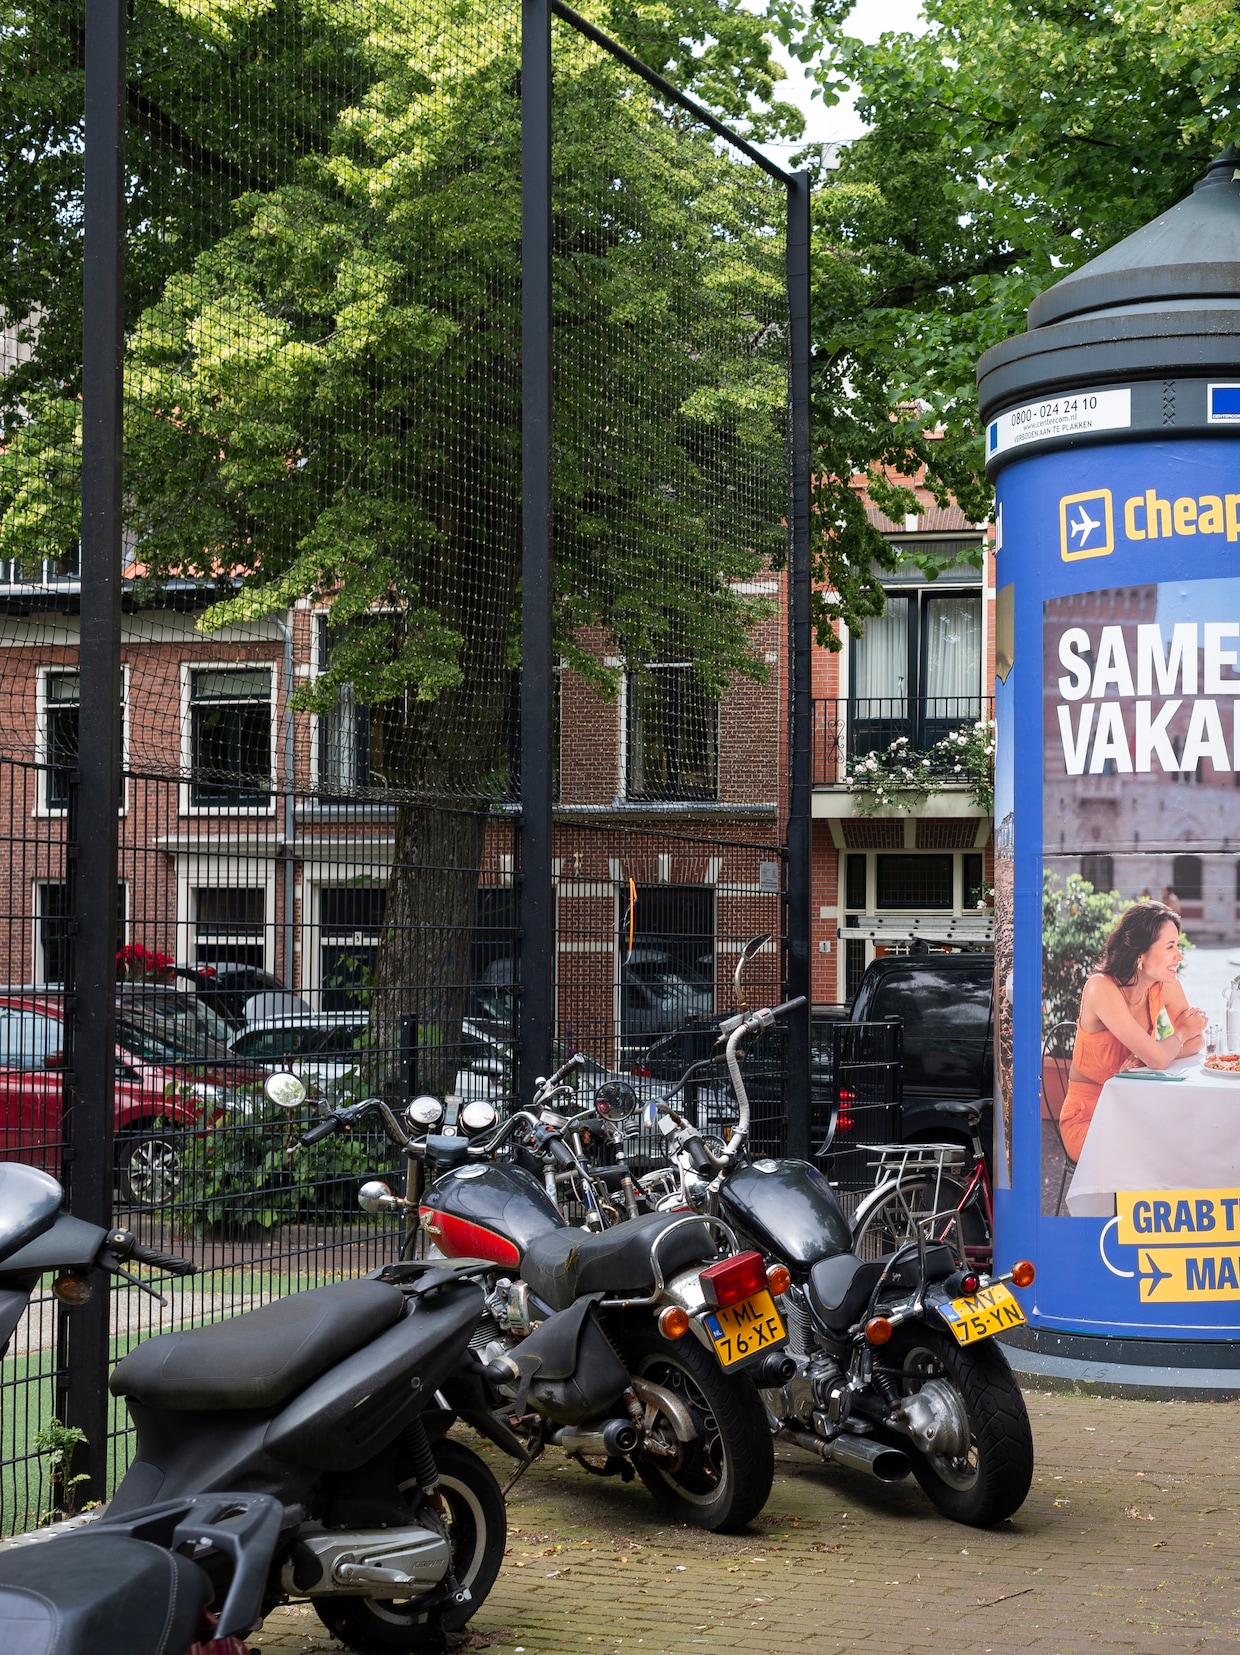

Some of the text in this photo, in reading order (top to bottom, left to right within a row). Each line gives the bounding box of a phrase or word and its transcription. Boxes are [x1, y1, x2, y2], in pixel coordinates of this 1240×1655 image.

[1011, 409, 1032, 427] 0800
[1040, 403, 1059, 418] 024
[1064, 400, 1078, 414] 24
[1083, 397, 1097, 410] 10
[1023, 413, 1078, 431] www.centercom.nl
[1014, 420, 1092, 443] VERBODEN AAN TE PLAKKEN
[1132, 1199, 1216, 1234] GRAB
[732, 1301, 764, 1327] ML
[963, 1291, 996, 1314] MV
[713, 1329, 723, 1338] NL
[957, 1304, 1024, 1341] 75-YN
[720, 1317, 778, 1361] 76-XF
